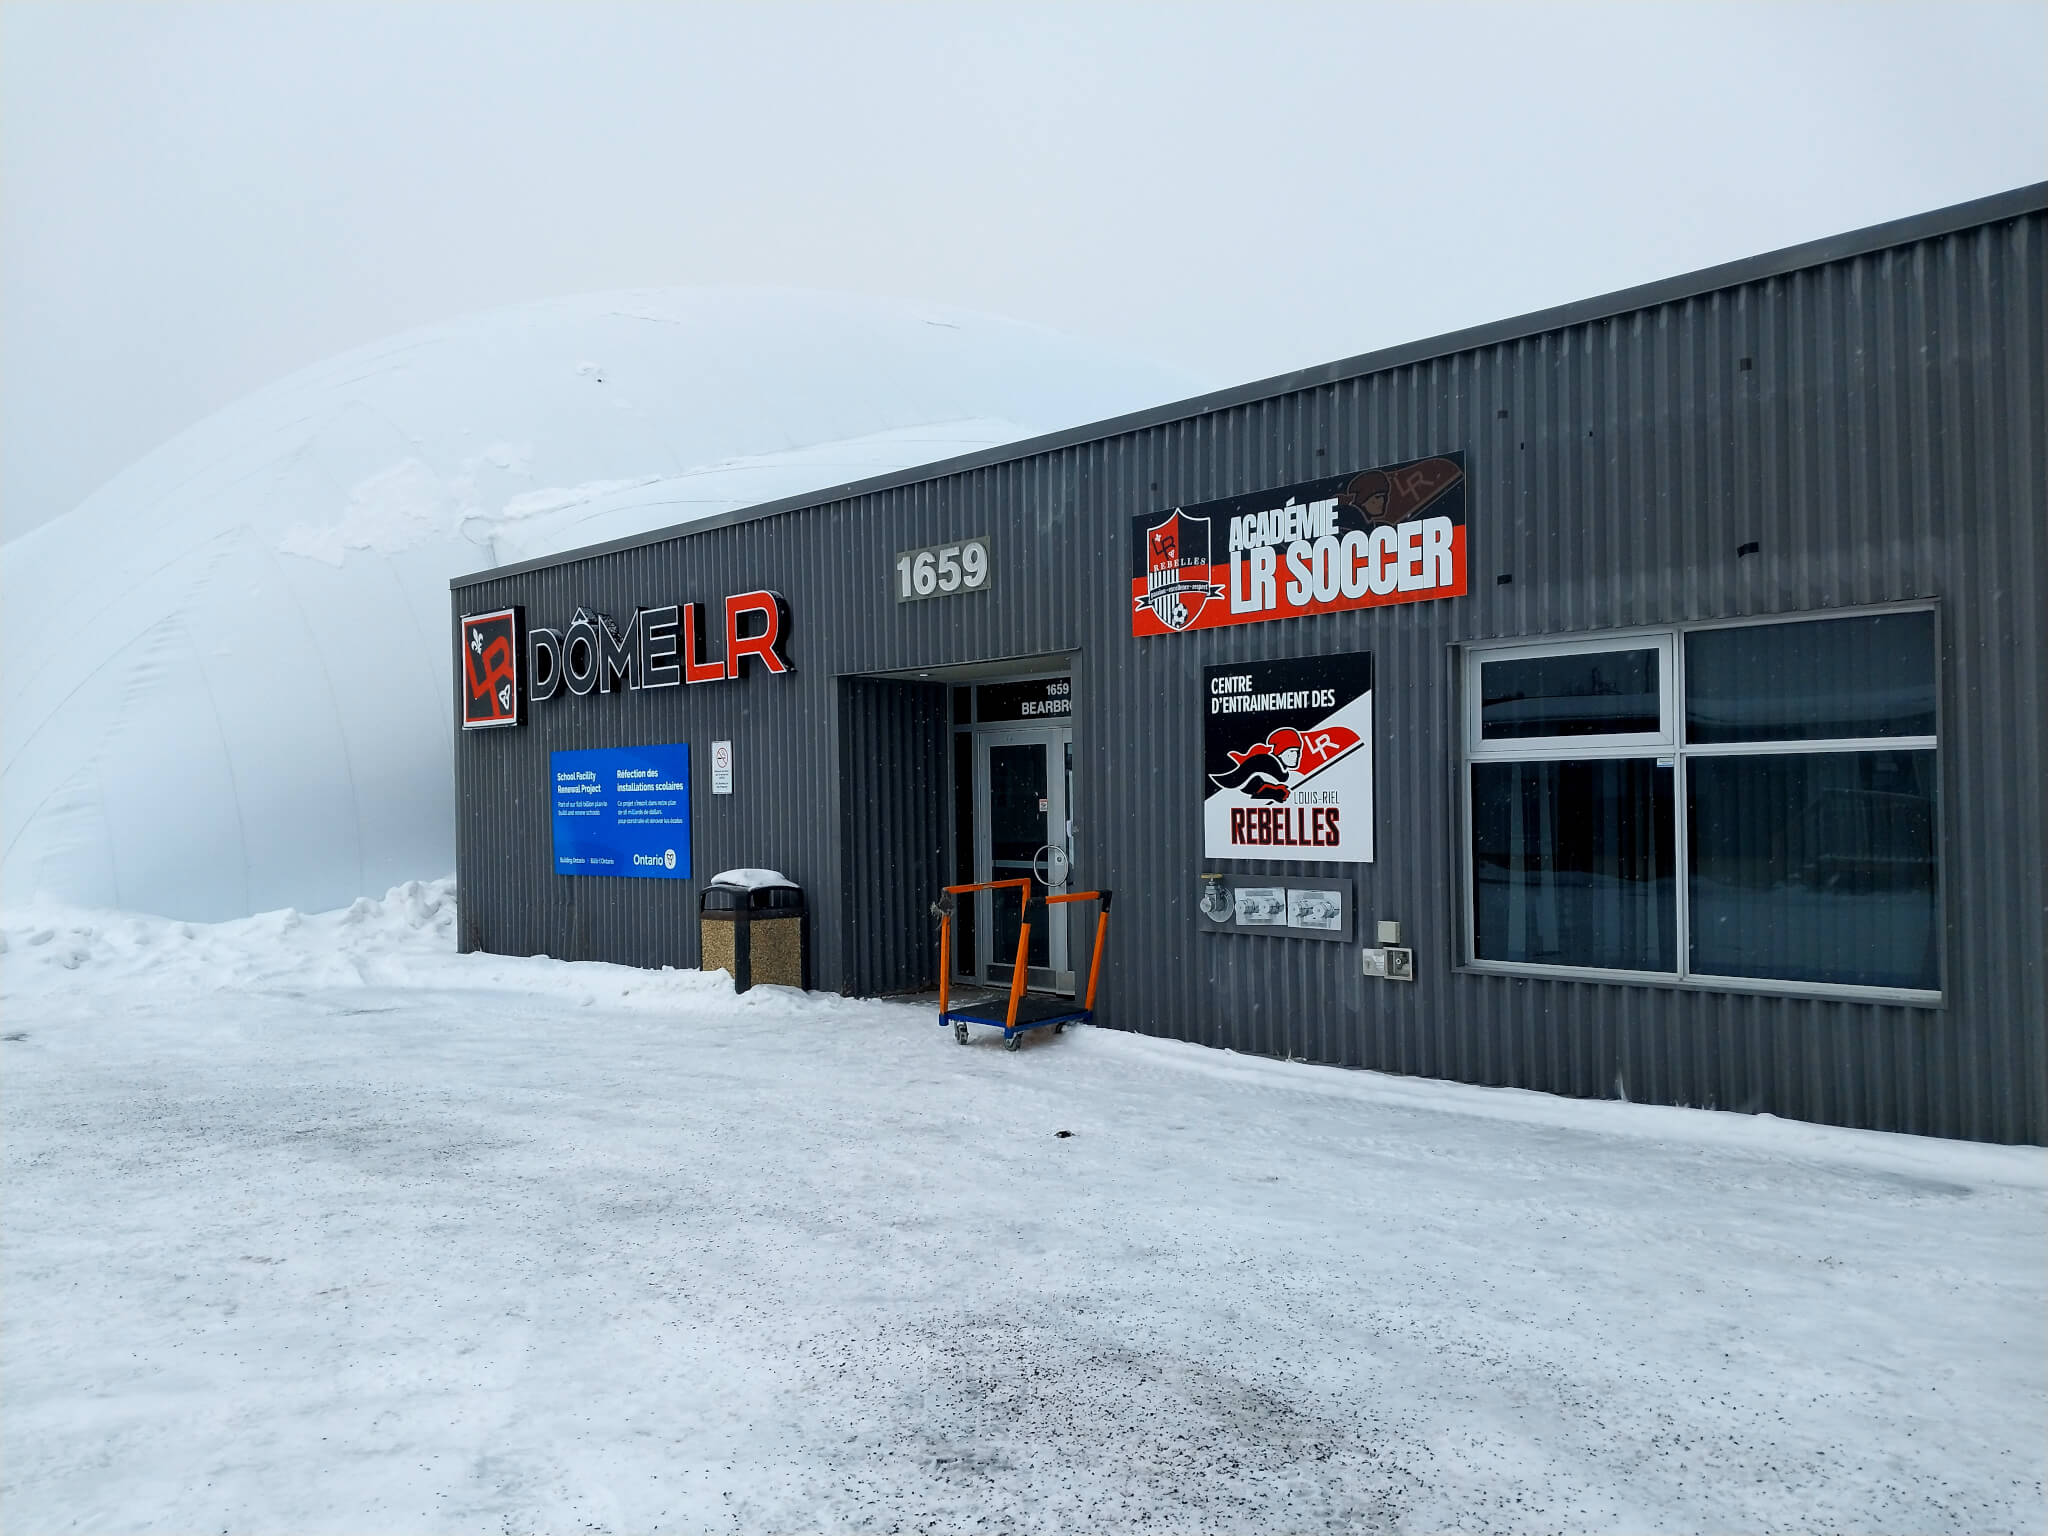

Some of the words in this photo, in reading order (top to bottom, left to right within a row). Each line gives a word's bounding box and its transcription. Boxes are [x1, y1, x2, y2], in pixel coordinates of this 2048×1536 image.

[1229, 496, 1339, 552] ACADÉMIE
[897, 542, 988, 597] 1659
[1153, 557, 1206, 572] REBELLES
[1230, 545, 1277, 615] LR
[1286, 516, 1454, 606] SOCCER
[1046, 682, 1069, 696] 1659
[1211, 675, 1253, 695] CENTRE
[1211, 690, 1309, 714] D'ENTRAINEMENT
[1312, 689, 1336, 708] DES
[557, 771, 576, 781] School
[576, 770, 596, 783] Facility
[647, 768, 659, 778] des
[557, 784, 581, 793] Renewal
[581, 784, 601, 795] Project
[617, 782, 655, 792] installations
[655, 780, 684, 791] scolaires
[1294, 791, 1340, 805] LOUIS-RIEL
[1231, 807, 1340, 847] REBELLES
[633, 854, 664, 866] Ontario
